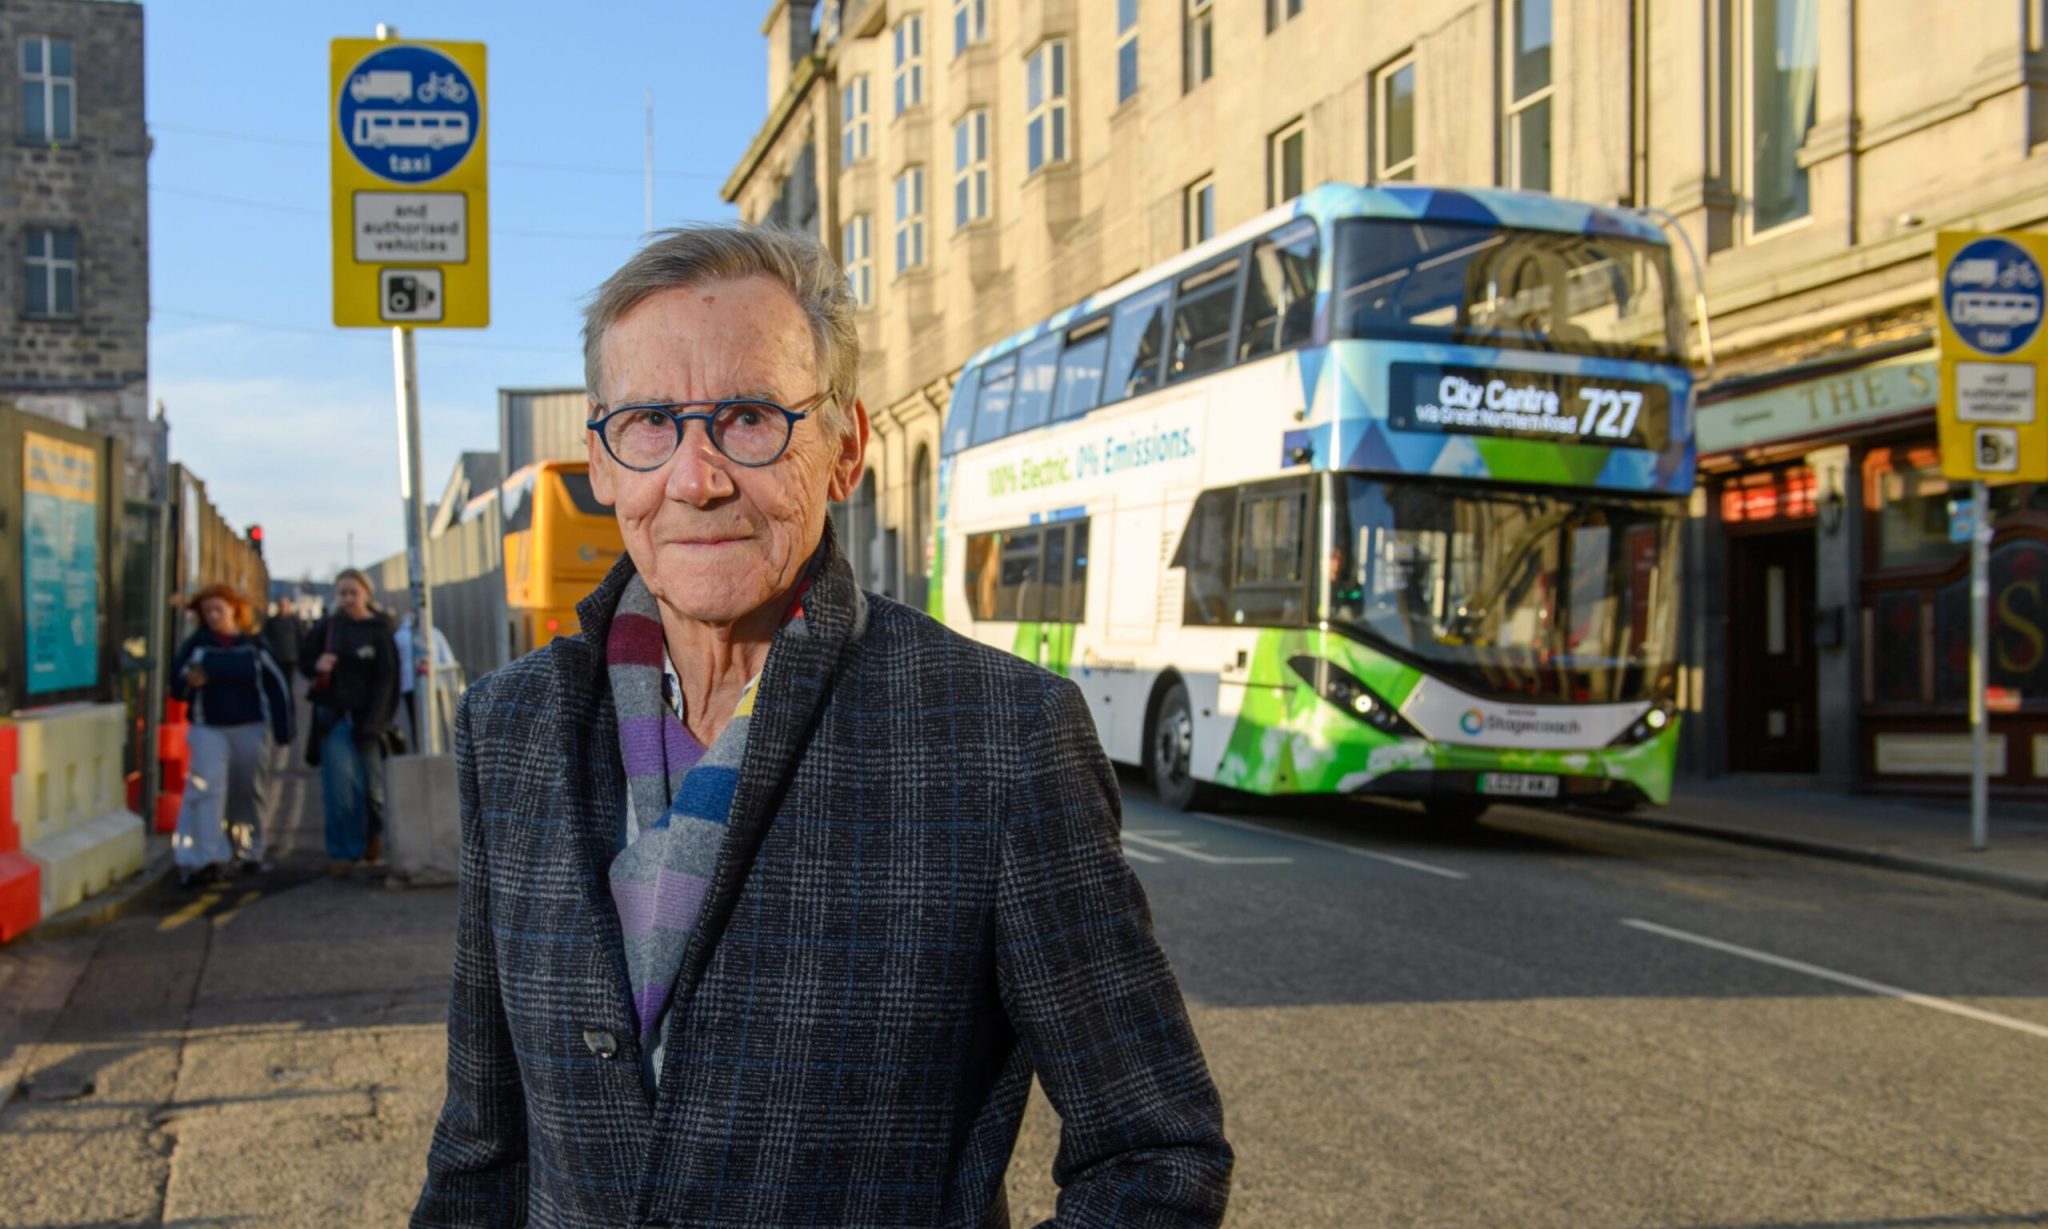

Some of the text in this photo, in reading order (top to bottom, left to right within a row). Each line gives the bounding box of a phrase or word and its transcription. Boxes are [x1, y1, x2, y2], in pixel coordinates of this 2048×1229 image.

[389, 153, 431, 172] taxi
[394, 204, 427, 217] and
[363, 219, 459, 235] authorised
[374, 237, 447, 251] vehicles
[1438, 375, 1560, 414] City Centre
[1796, 373, 1889, 421] THE
[1579, 387, 1644, 438] 727
[1487, 715, 1582, 735] Stagecoach
